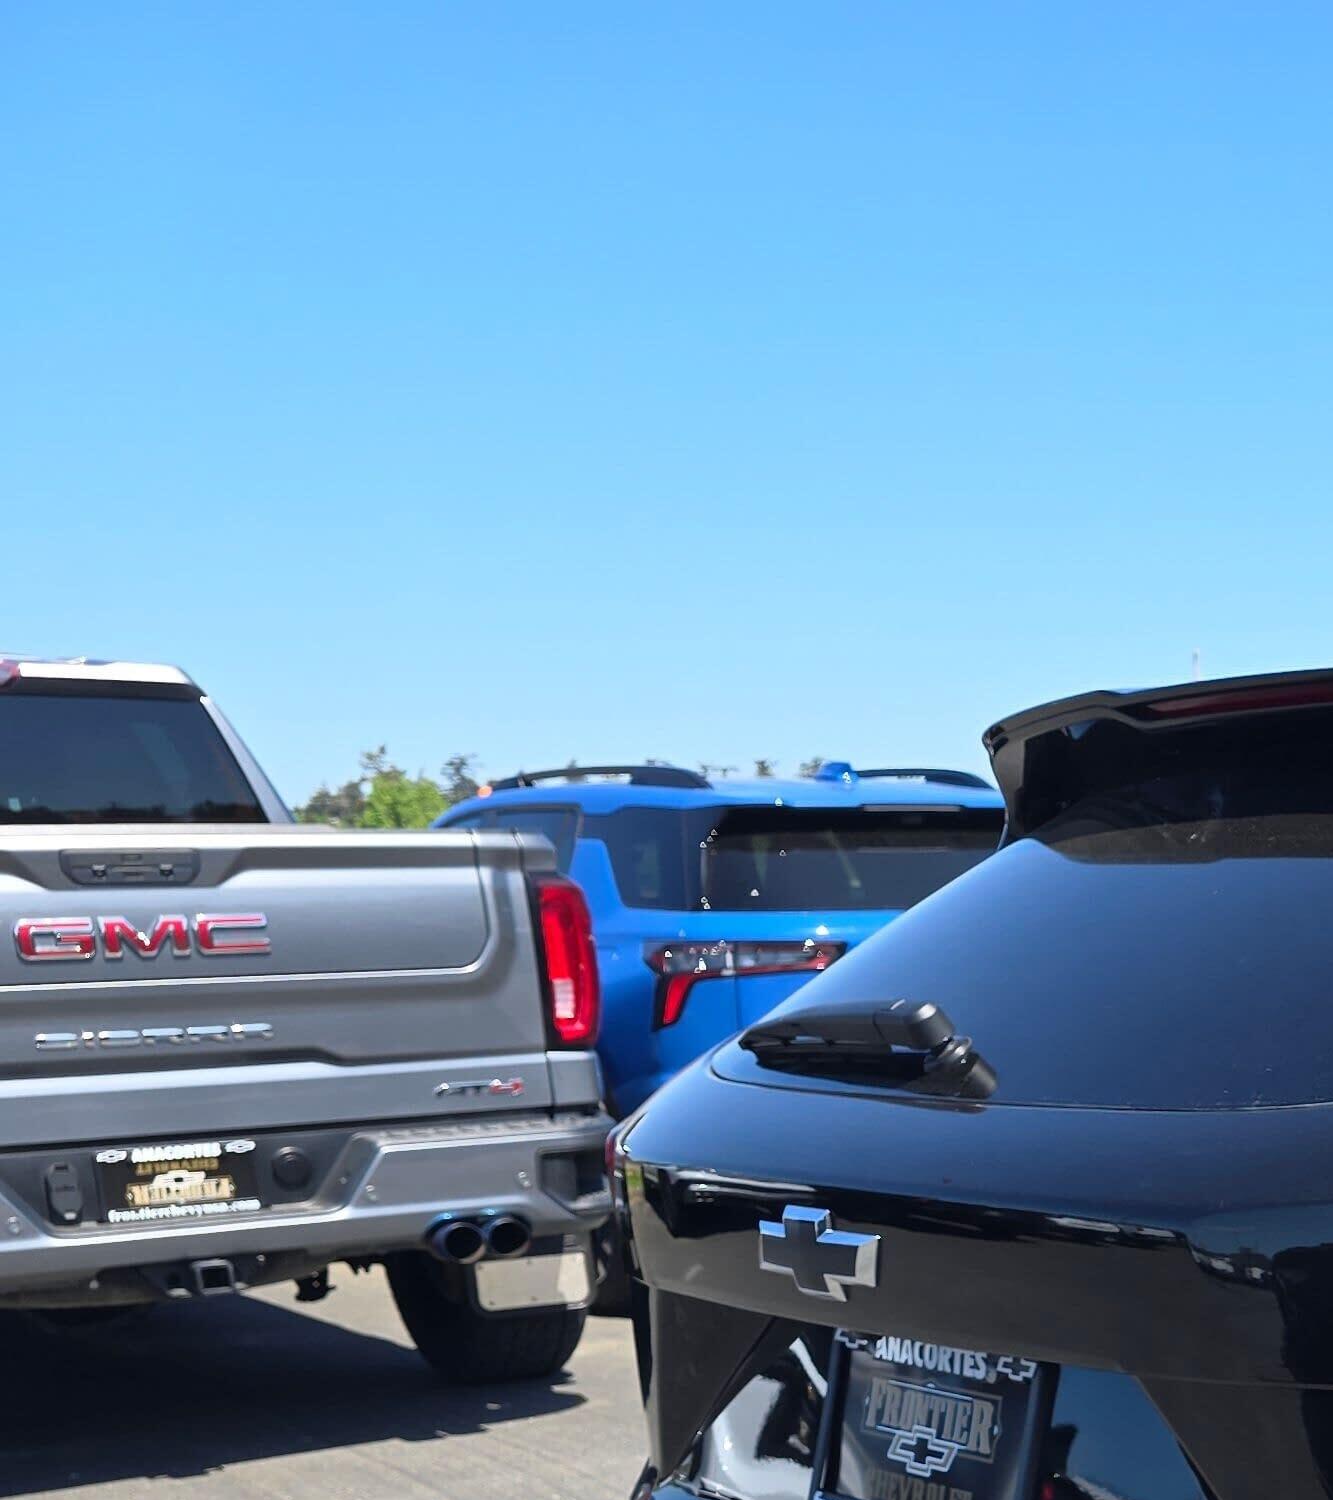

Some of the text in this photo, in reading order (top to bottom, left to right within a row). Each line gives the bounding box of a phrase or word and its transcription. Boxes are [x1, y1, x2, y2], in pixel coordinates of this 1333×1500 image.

[13, 911, 272, 962] GMC
[874, 1335, 989, 1381] ANACORTES
[865, 1377, 994, 1455] FRONTIER
